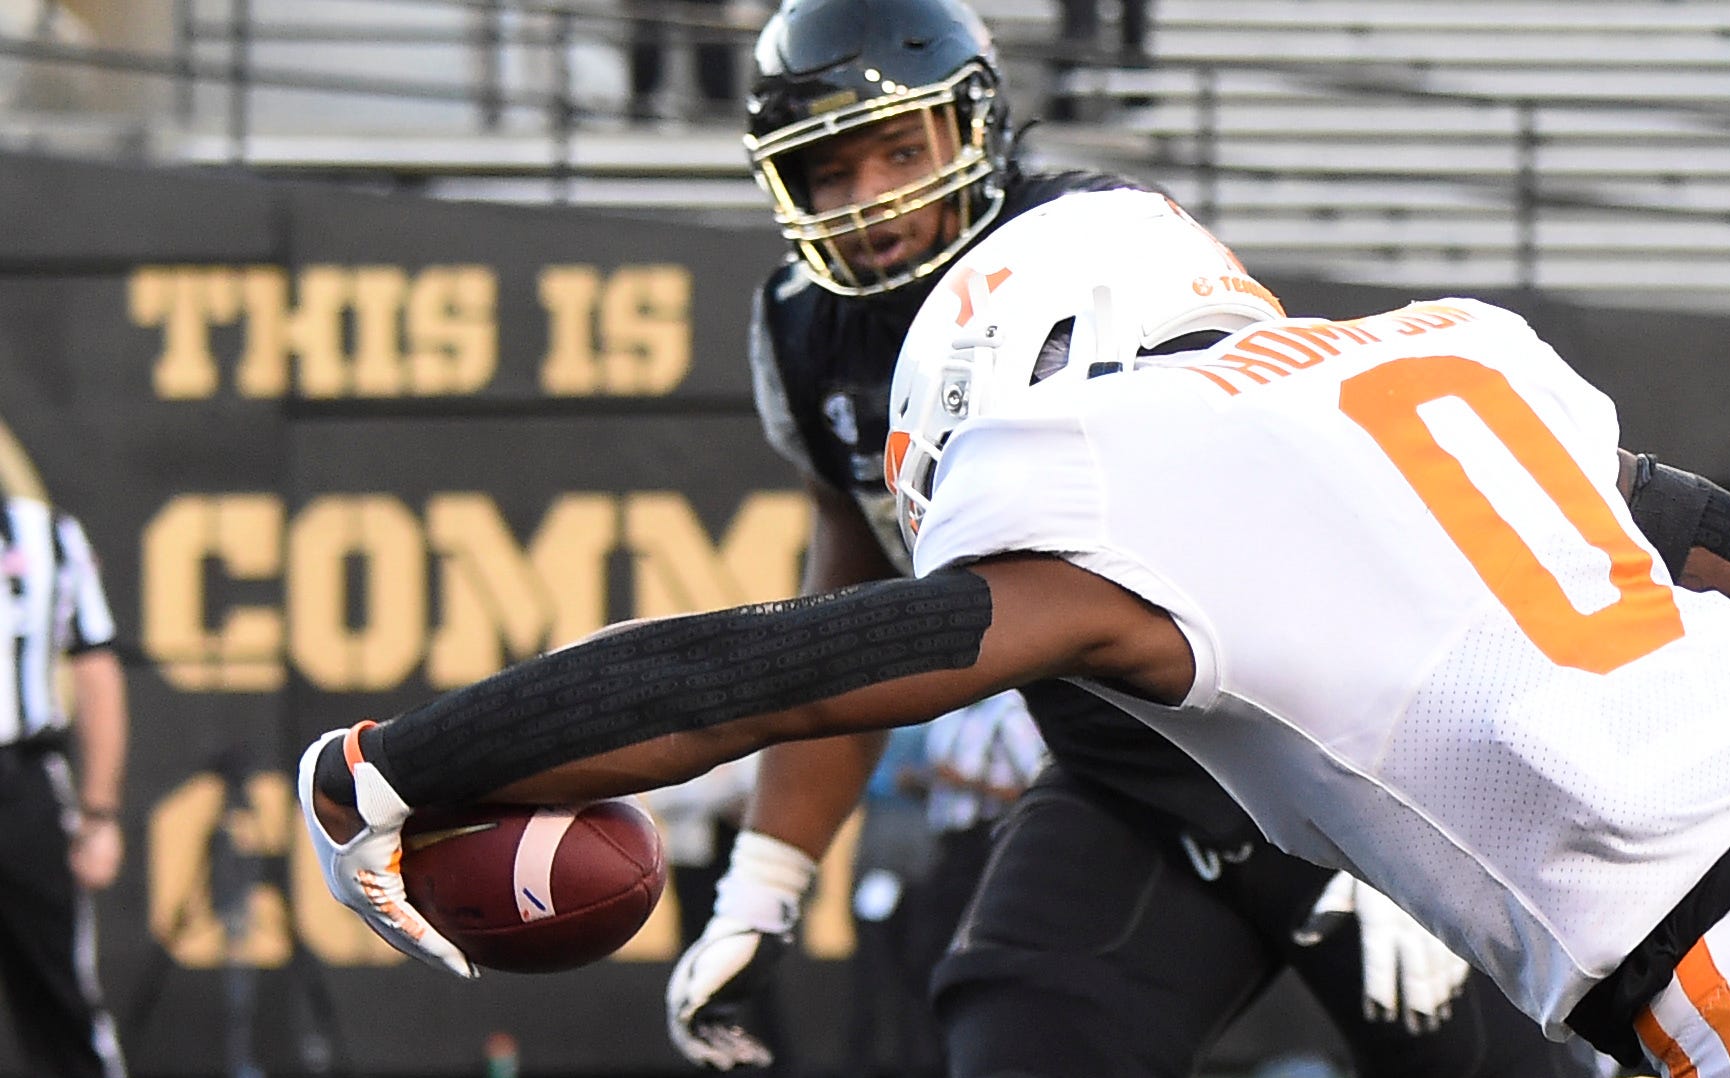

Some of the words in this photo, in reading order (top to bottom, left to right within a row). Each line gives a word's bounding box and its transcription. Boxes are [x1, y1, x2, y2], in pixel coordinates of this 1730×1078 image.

[130, 266, 498, 399] THIS
[538, 266, 694, 397] IS
[141, 492, 813, 692] COMM
[1338, 355, 1687, 676] 0
